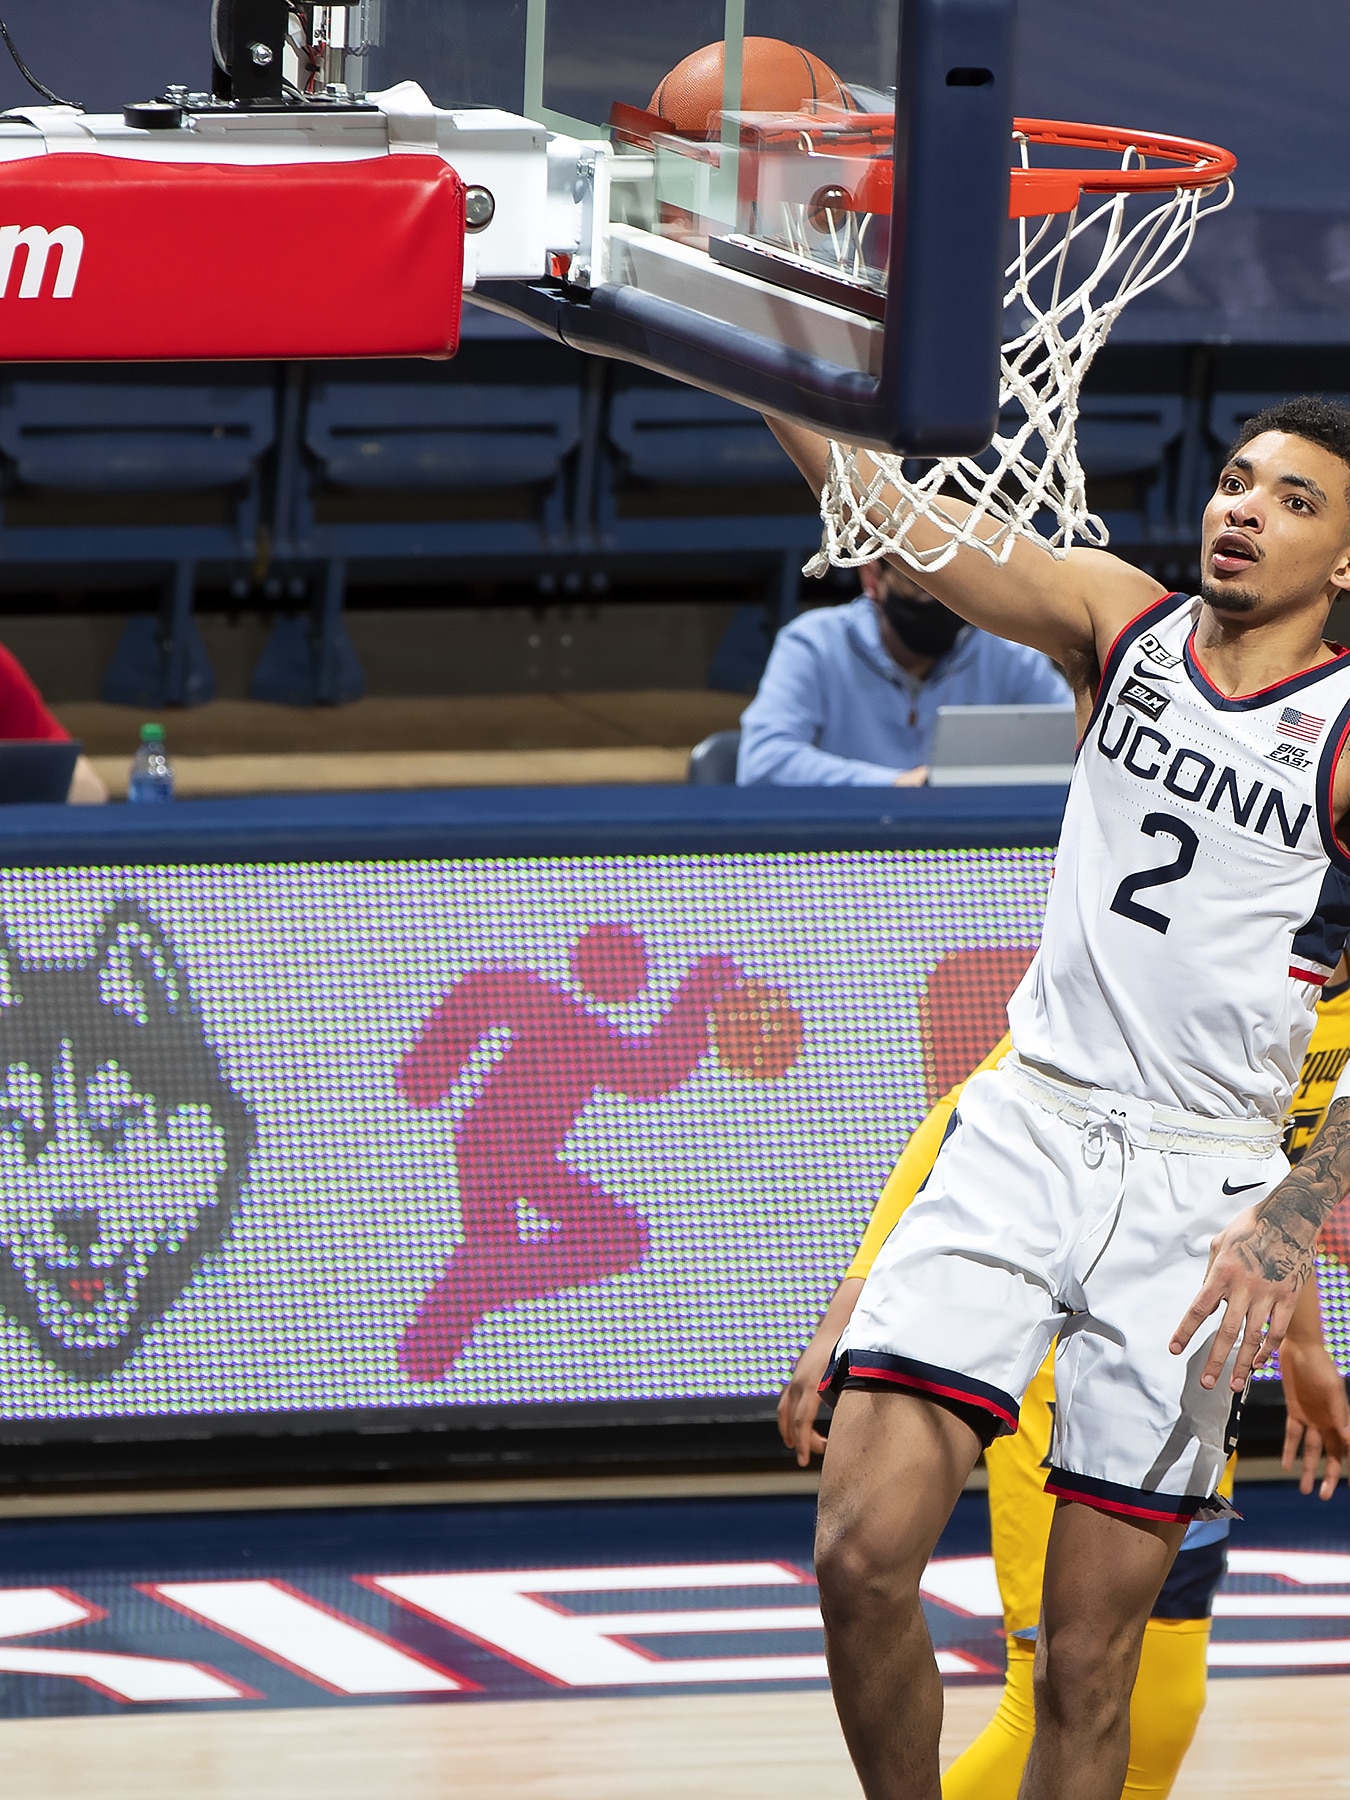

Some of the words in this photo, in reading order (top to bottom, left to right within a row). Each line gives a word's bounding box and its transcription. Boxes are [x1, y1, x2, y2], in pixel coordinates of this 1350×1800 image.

[0, 224, 84, 299] m
[1139, 634, 1183, 669] DEE
[1097, 704, 1312, 849] UCONN
[1269, 751, 1313, 769] EAST
[1277, 743, 1309, 758] BIG
[1109, 812, 1199, 935] 2
